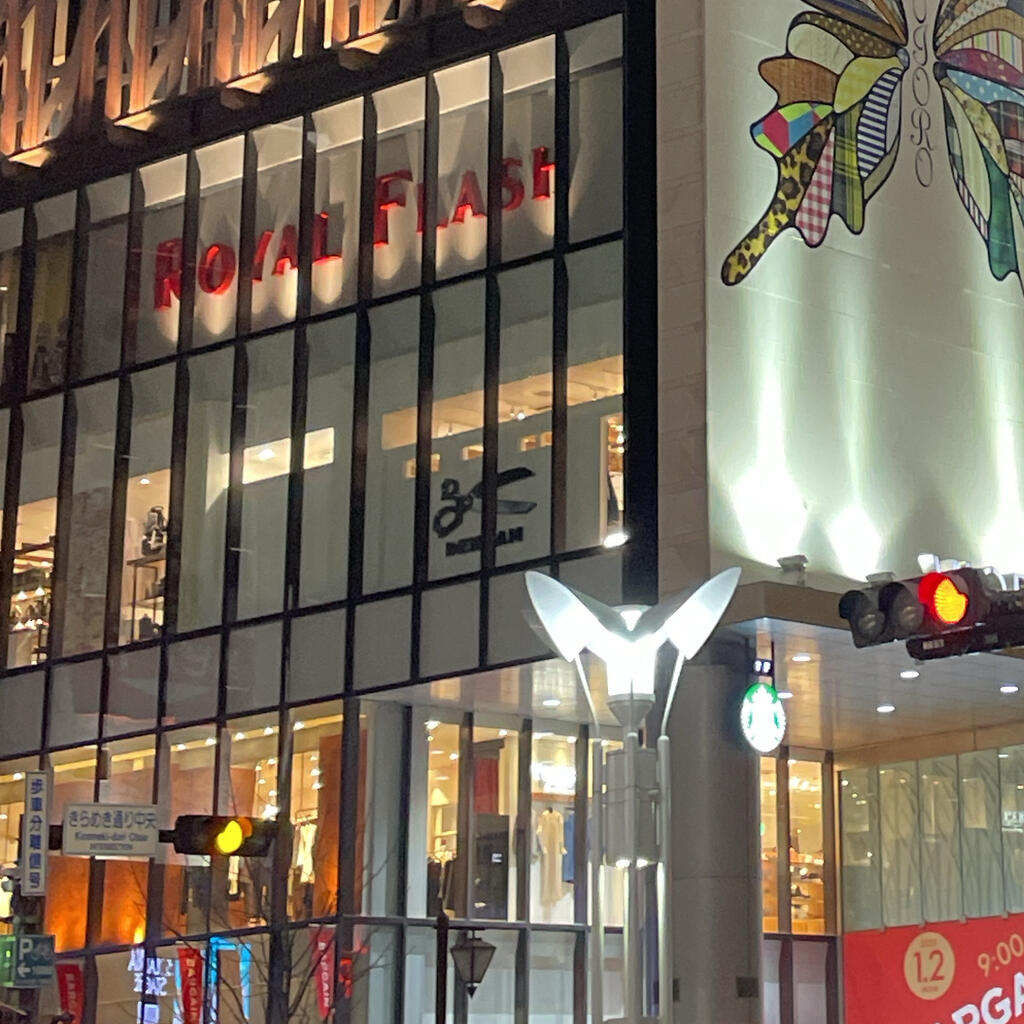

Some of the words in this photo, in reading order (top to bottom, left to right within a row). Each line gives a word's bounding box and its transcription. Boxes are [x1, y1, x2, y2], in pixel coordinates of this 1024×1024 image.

[446, 527, 524, 557] DENAM
[20, 938, 33, 961] P
[914, 948, 945, 983] 1.2
[977, 933, 1024, 977] 9:00
